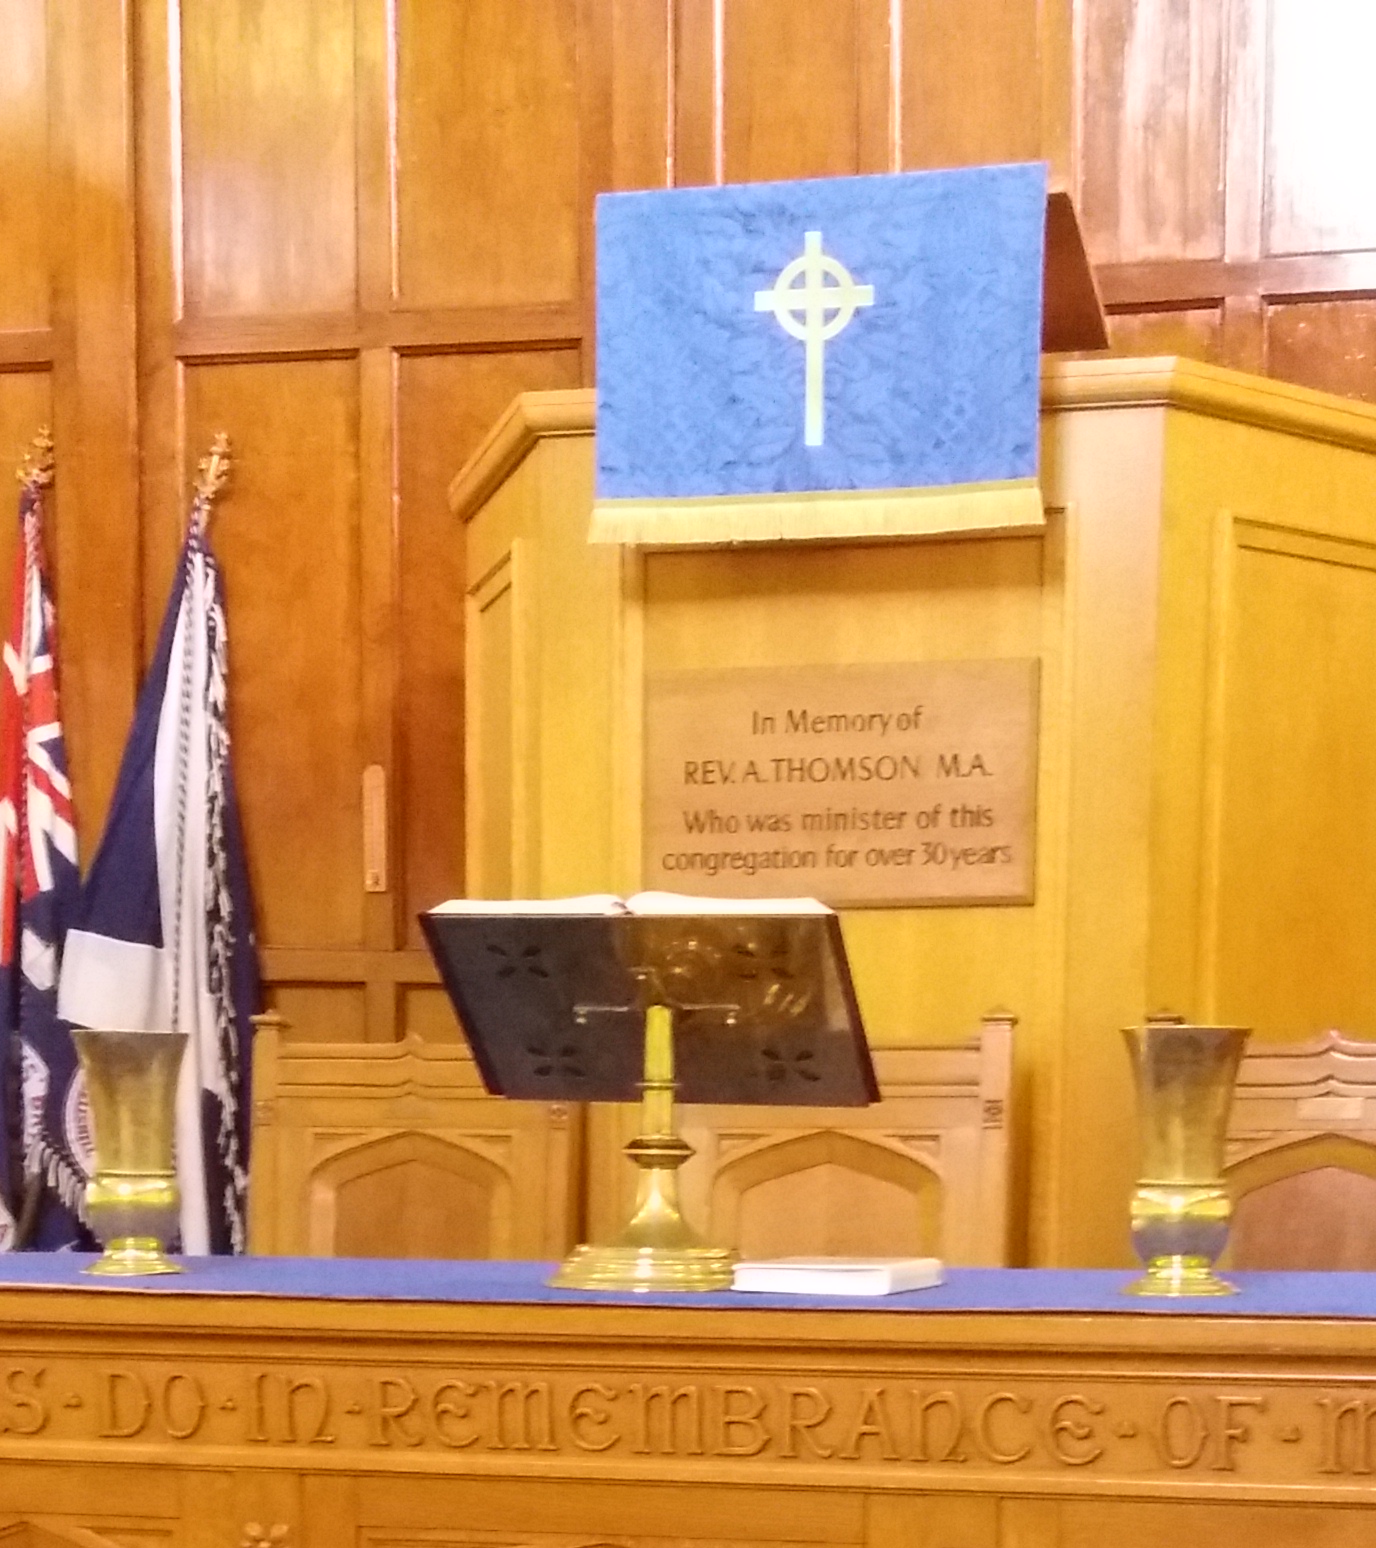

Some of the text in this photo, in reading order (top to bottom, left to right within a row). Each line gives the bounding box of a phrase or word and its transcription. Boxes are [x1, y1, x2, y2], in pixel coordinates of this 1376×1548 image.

[751, 704, 924, 738] In Memory of
[684, 759, 735, 785] REV.
[770, 754, 922, 784] THOMSON
[935, 752, 994, 778] M.A.
[681, 803, 994, 836] Who was minister of this
[661, 841, 1013, 877] congregation for over 30 years
[96, 1368, 207, 1441] DO
[1152, 1393, 1268, 1473] OF
